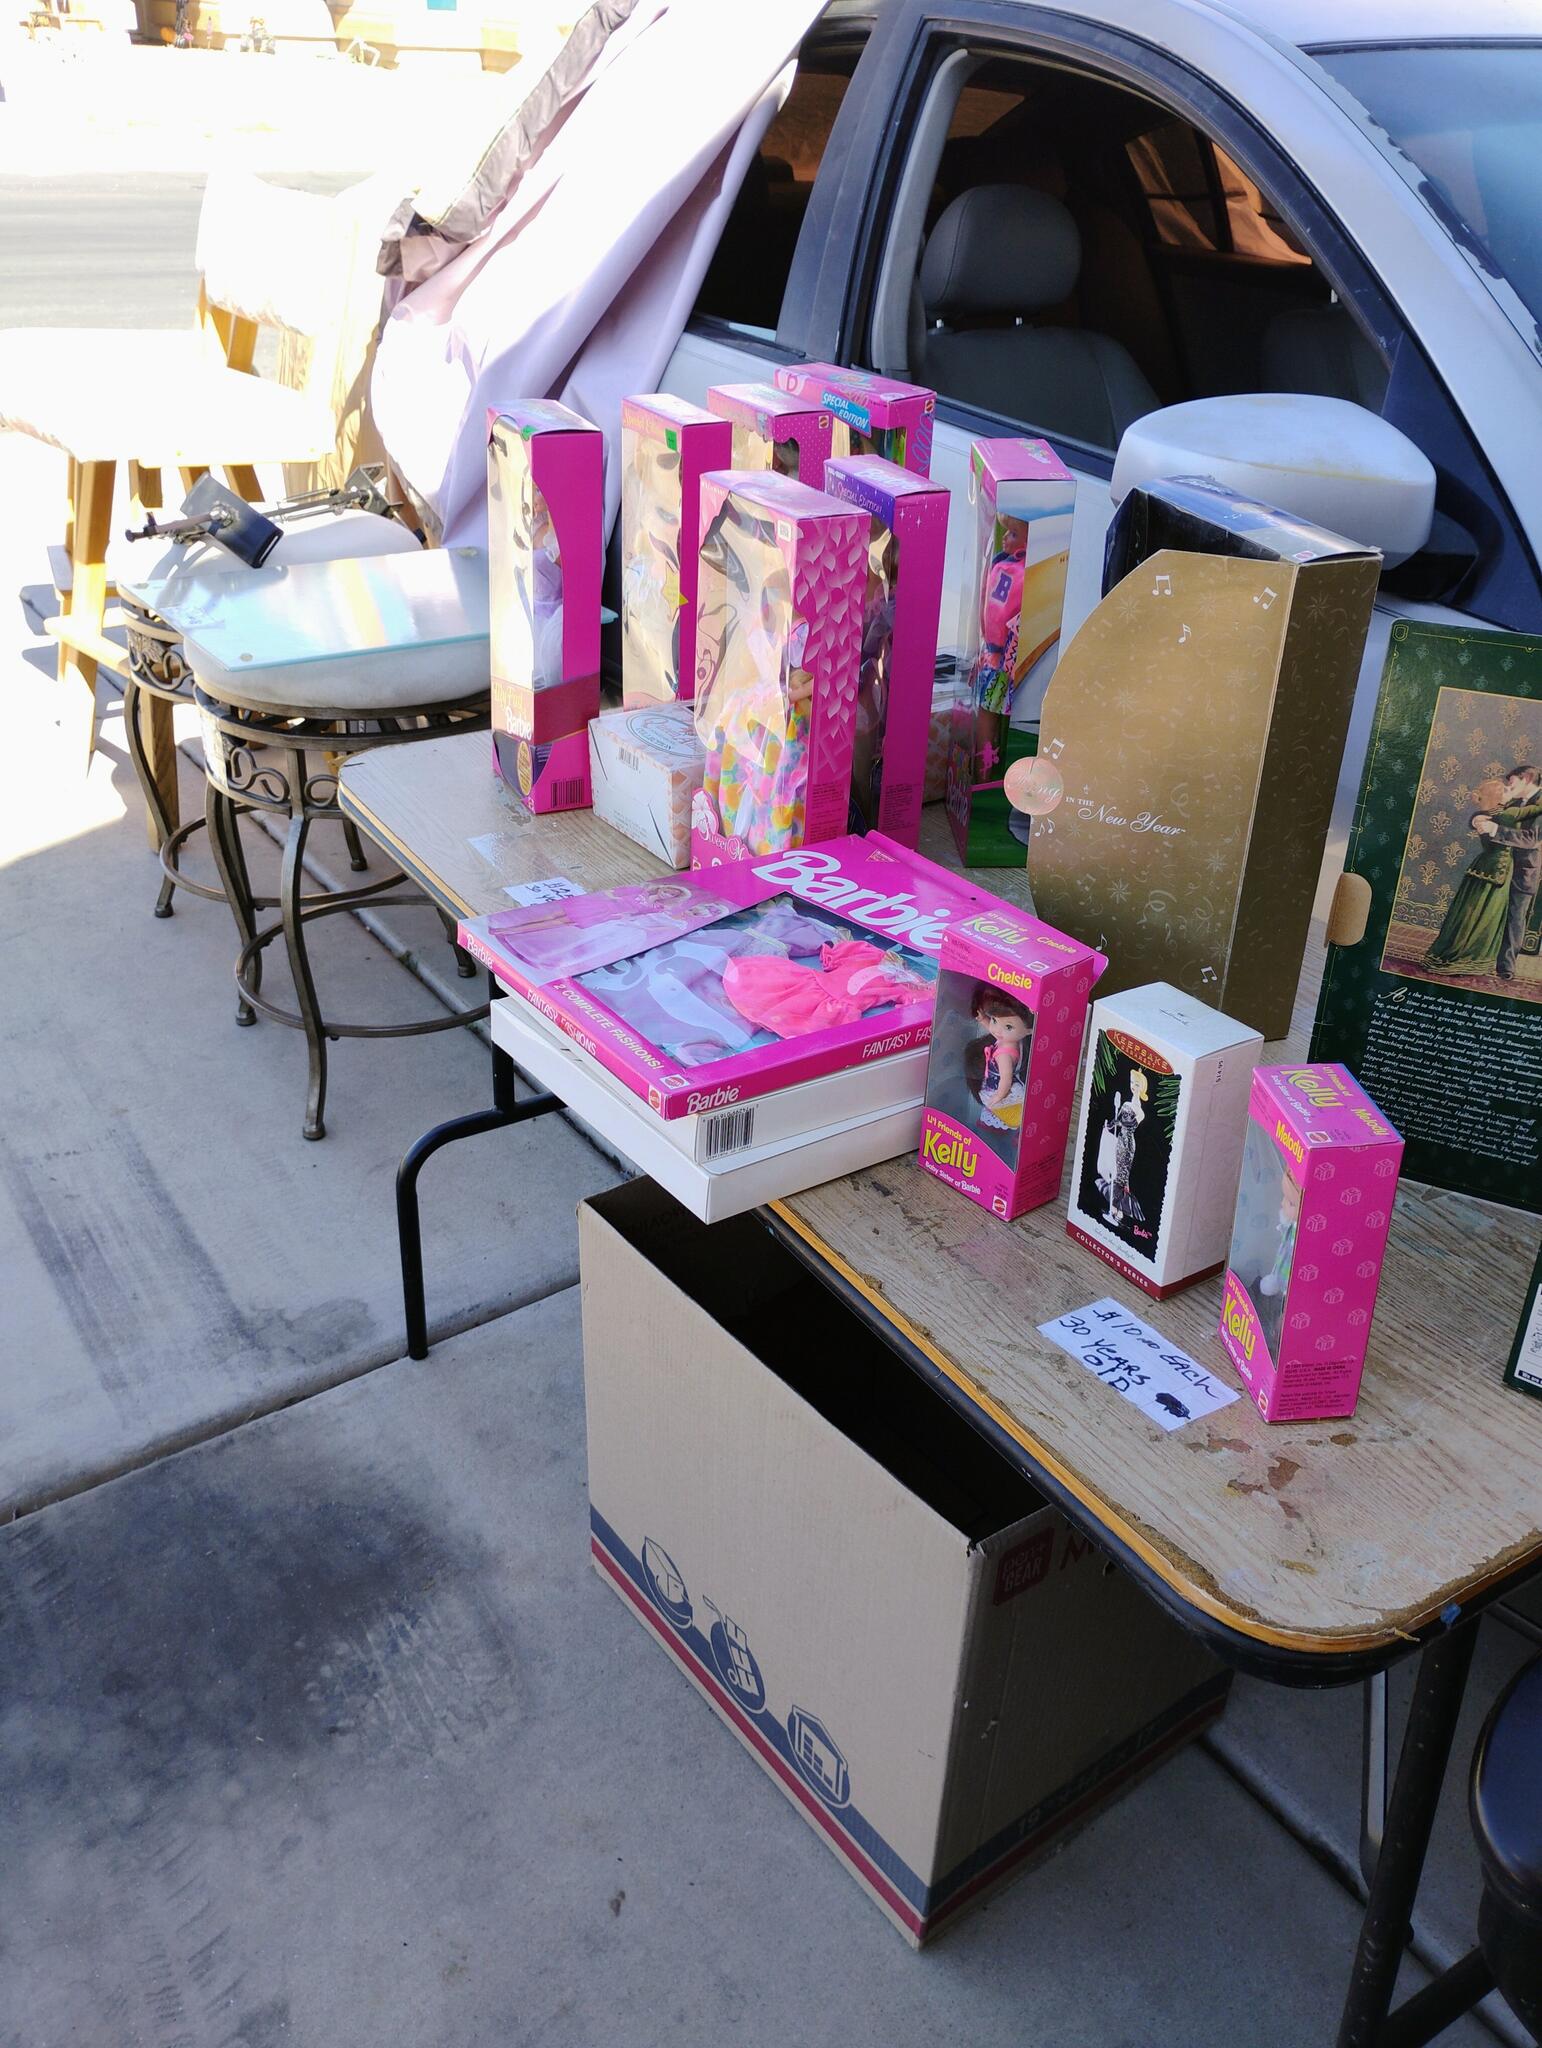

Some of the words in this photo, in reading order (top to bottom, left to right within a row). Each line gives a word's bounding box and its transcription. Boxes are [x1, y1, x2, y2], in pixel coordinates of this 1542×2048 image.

[823, 392, 850, 409] SPECIAL
[839, 409, 869, 428] EDITION
[506, 709, 532, 739] Barbie
[1065, 796, 1075, 804] IN
[1077, 798, 1095, 807] THE
[1078, 804, 1128, 827] New
[751, 850, 951, 949] Barbie
[962, 916, 1030, 945] Kelly
[466, 933, 494, 969] Barbie
[988, 963, 1032, 990] Chelsie
[527, 988, 558, 1023] FANTASY
[561, 988, 614, 1030] COMPLETE
[609, 1027, 665, 1070] FASHIONS!
[1113, 1032, 1169, 1070] KEEPSAKE
[687, 1086, 739, 1114] Barbie
[862, 1031, 912, 1059] FANTASY
[1280, 1068, 1345, 1108] Kelly
[937, 1120, 962, 1141] Friends
[963, 1136, 972, 1146] of
[1276, 1120, 1305, 1163] Melody
[923, 1129, 977, 1178] Kelly
[1076, 1232, 1121, 1267] COLLECTOR'S
[1123, 1266, 1148, 1287] SERIES
[1058, 1315, 1092, 1336] 30
[1223, 1292, 1256, 1361] Kelly
